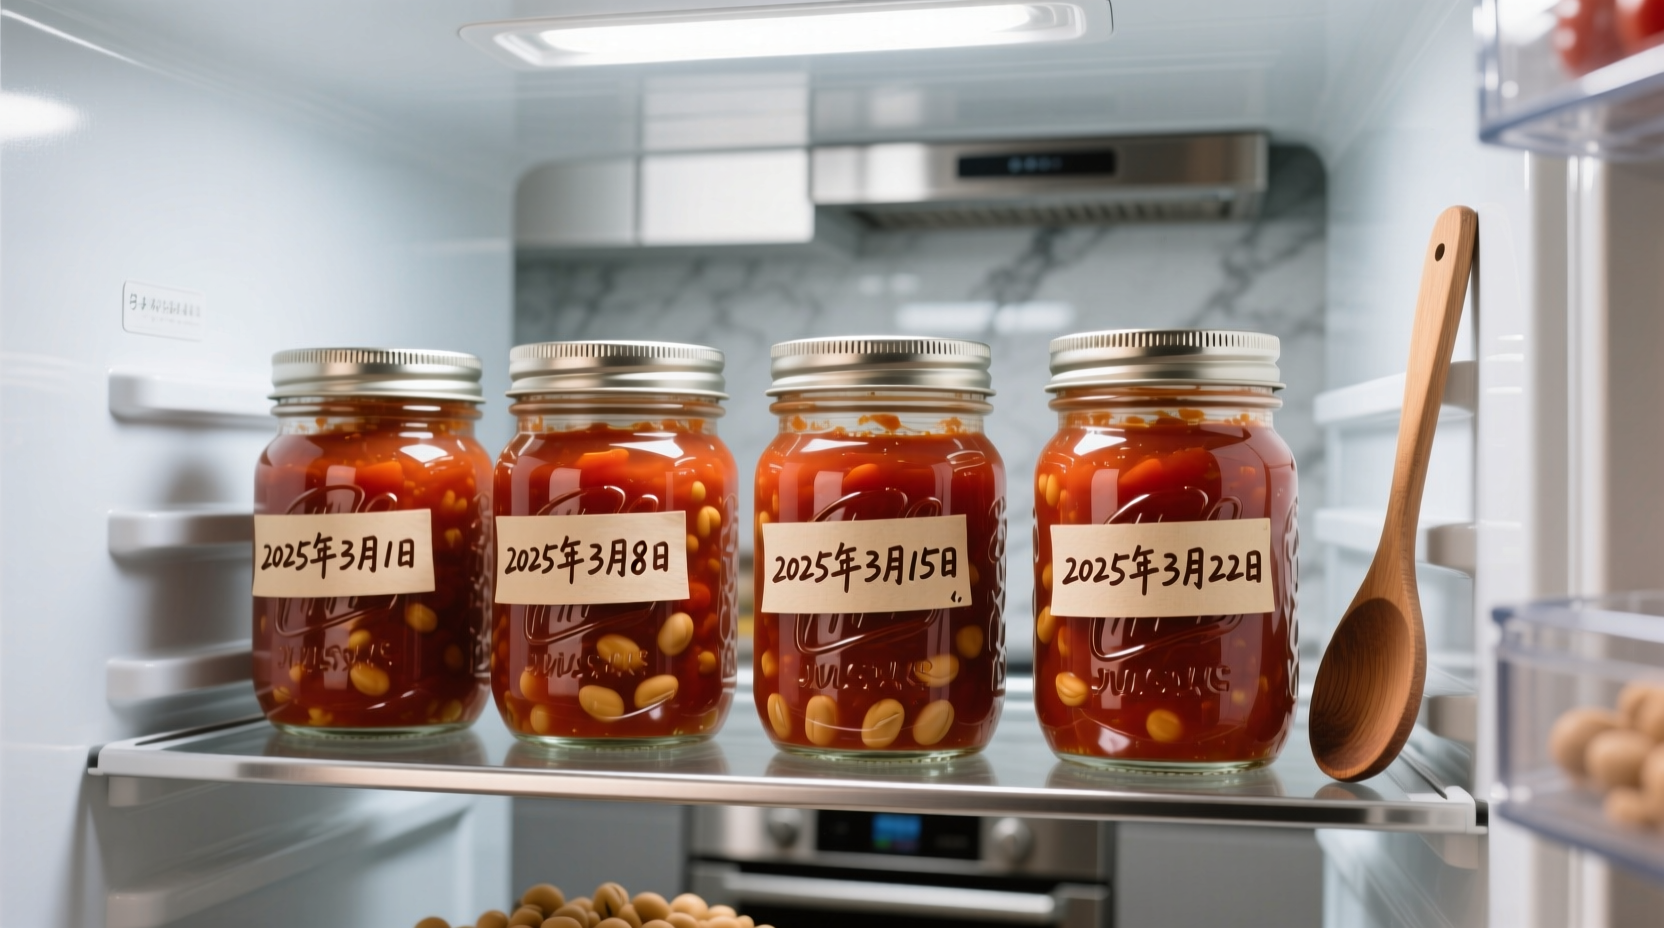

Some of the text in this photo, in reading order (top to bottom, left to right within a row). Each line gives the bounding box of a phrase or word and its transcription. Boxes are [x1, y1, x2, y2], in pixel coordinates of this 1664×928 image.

[261, 532, 415, 579] 2025年3月1日
[504, 535, 669, 584] 2025年3月8日
[772, 542, 957, 593] 2025年3月15日
[1062, 544, 1262, 596] 2025年3月22日
